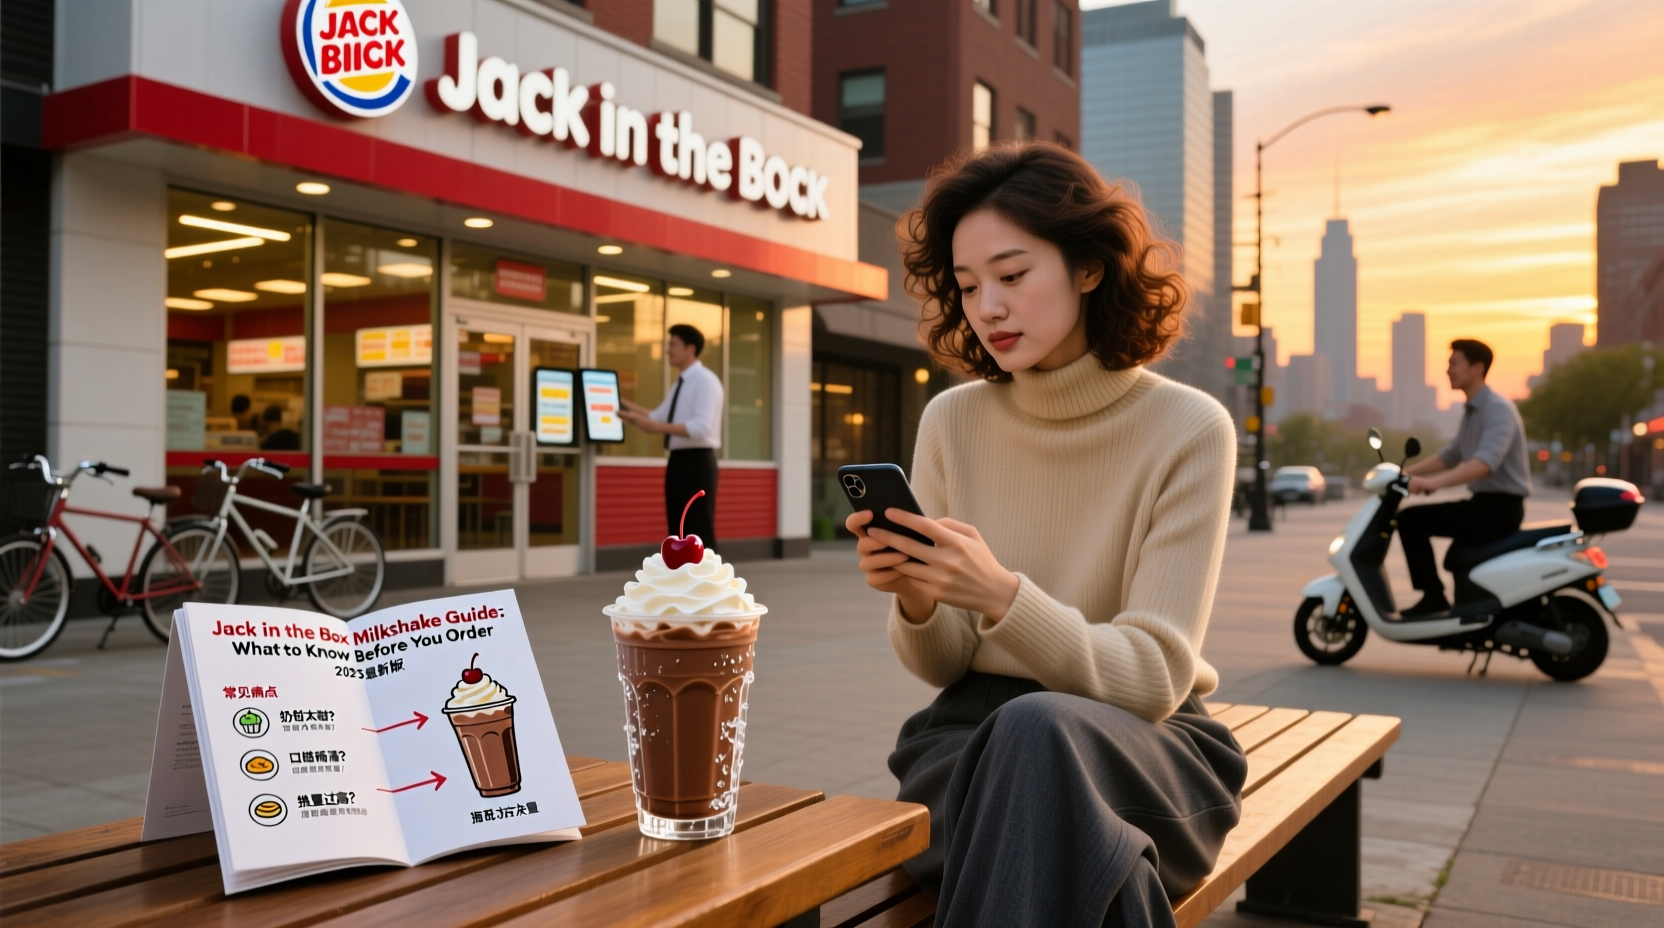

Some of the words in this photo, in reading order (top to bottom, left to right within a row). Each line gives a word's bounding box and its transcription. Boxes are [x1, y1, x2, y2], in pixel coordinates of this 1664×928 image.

[319, 9, 400, 40] JACK
[438, 31, 591, 149] Jack
[600, 82, 649, 166] in
[654, 110, 733, 191] the
[212, 620, 257, 638] Jack
[262, 622, 281, 638] in
[285, 624, 315, 640] the
[319, 627, 350, 646] Box
[353, 614, 442, 646] Milkshake
[445, 605, 505, 625] Guide:
[232, 641, 281, 656] What
[283, 643, 301, 657] to
[305, 644, 350, 661] Know
[355, 641, 408, 663] Before
[410, 633, 443, 648] You
[446, 625, 494, 643] Order
